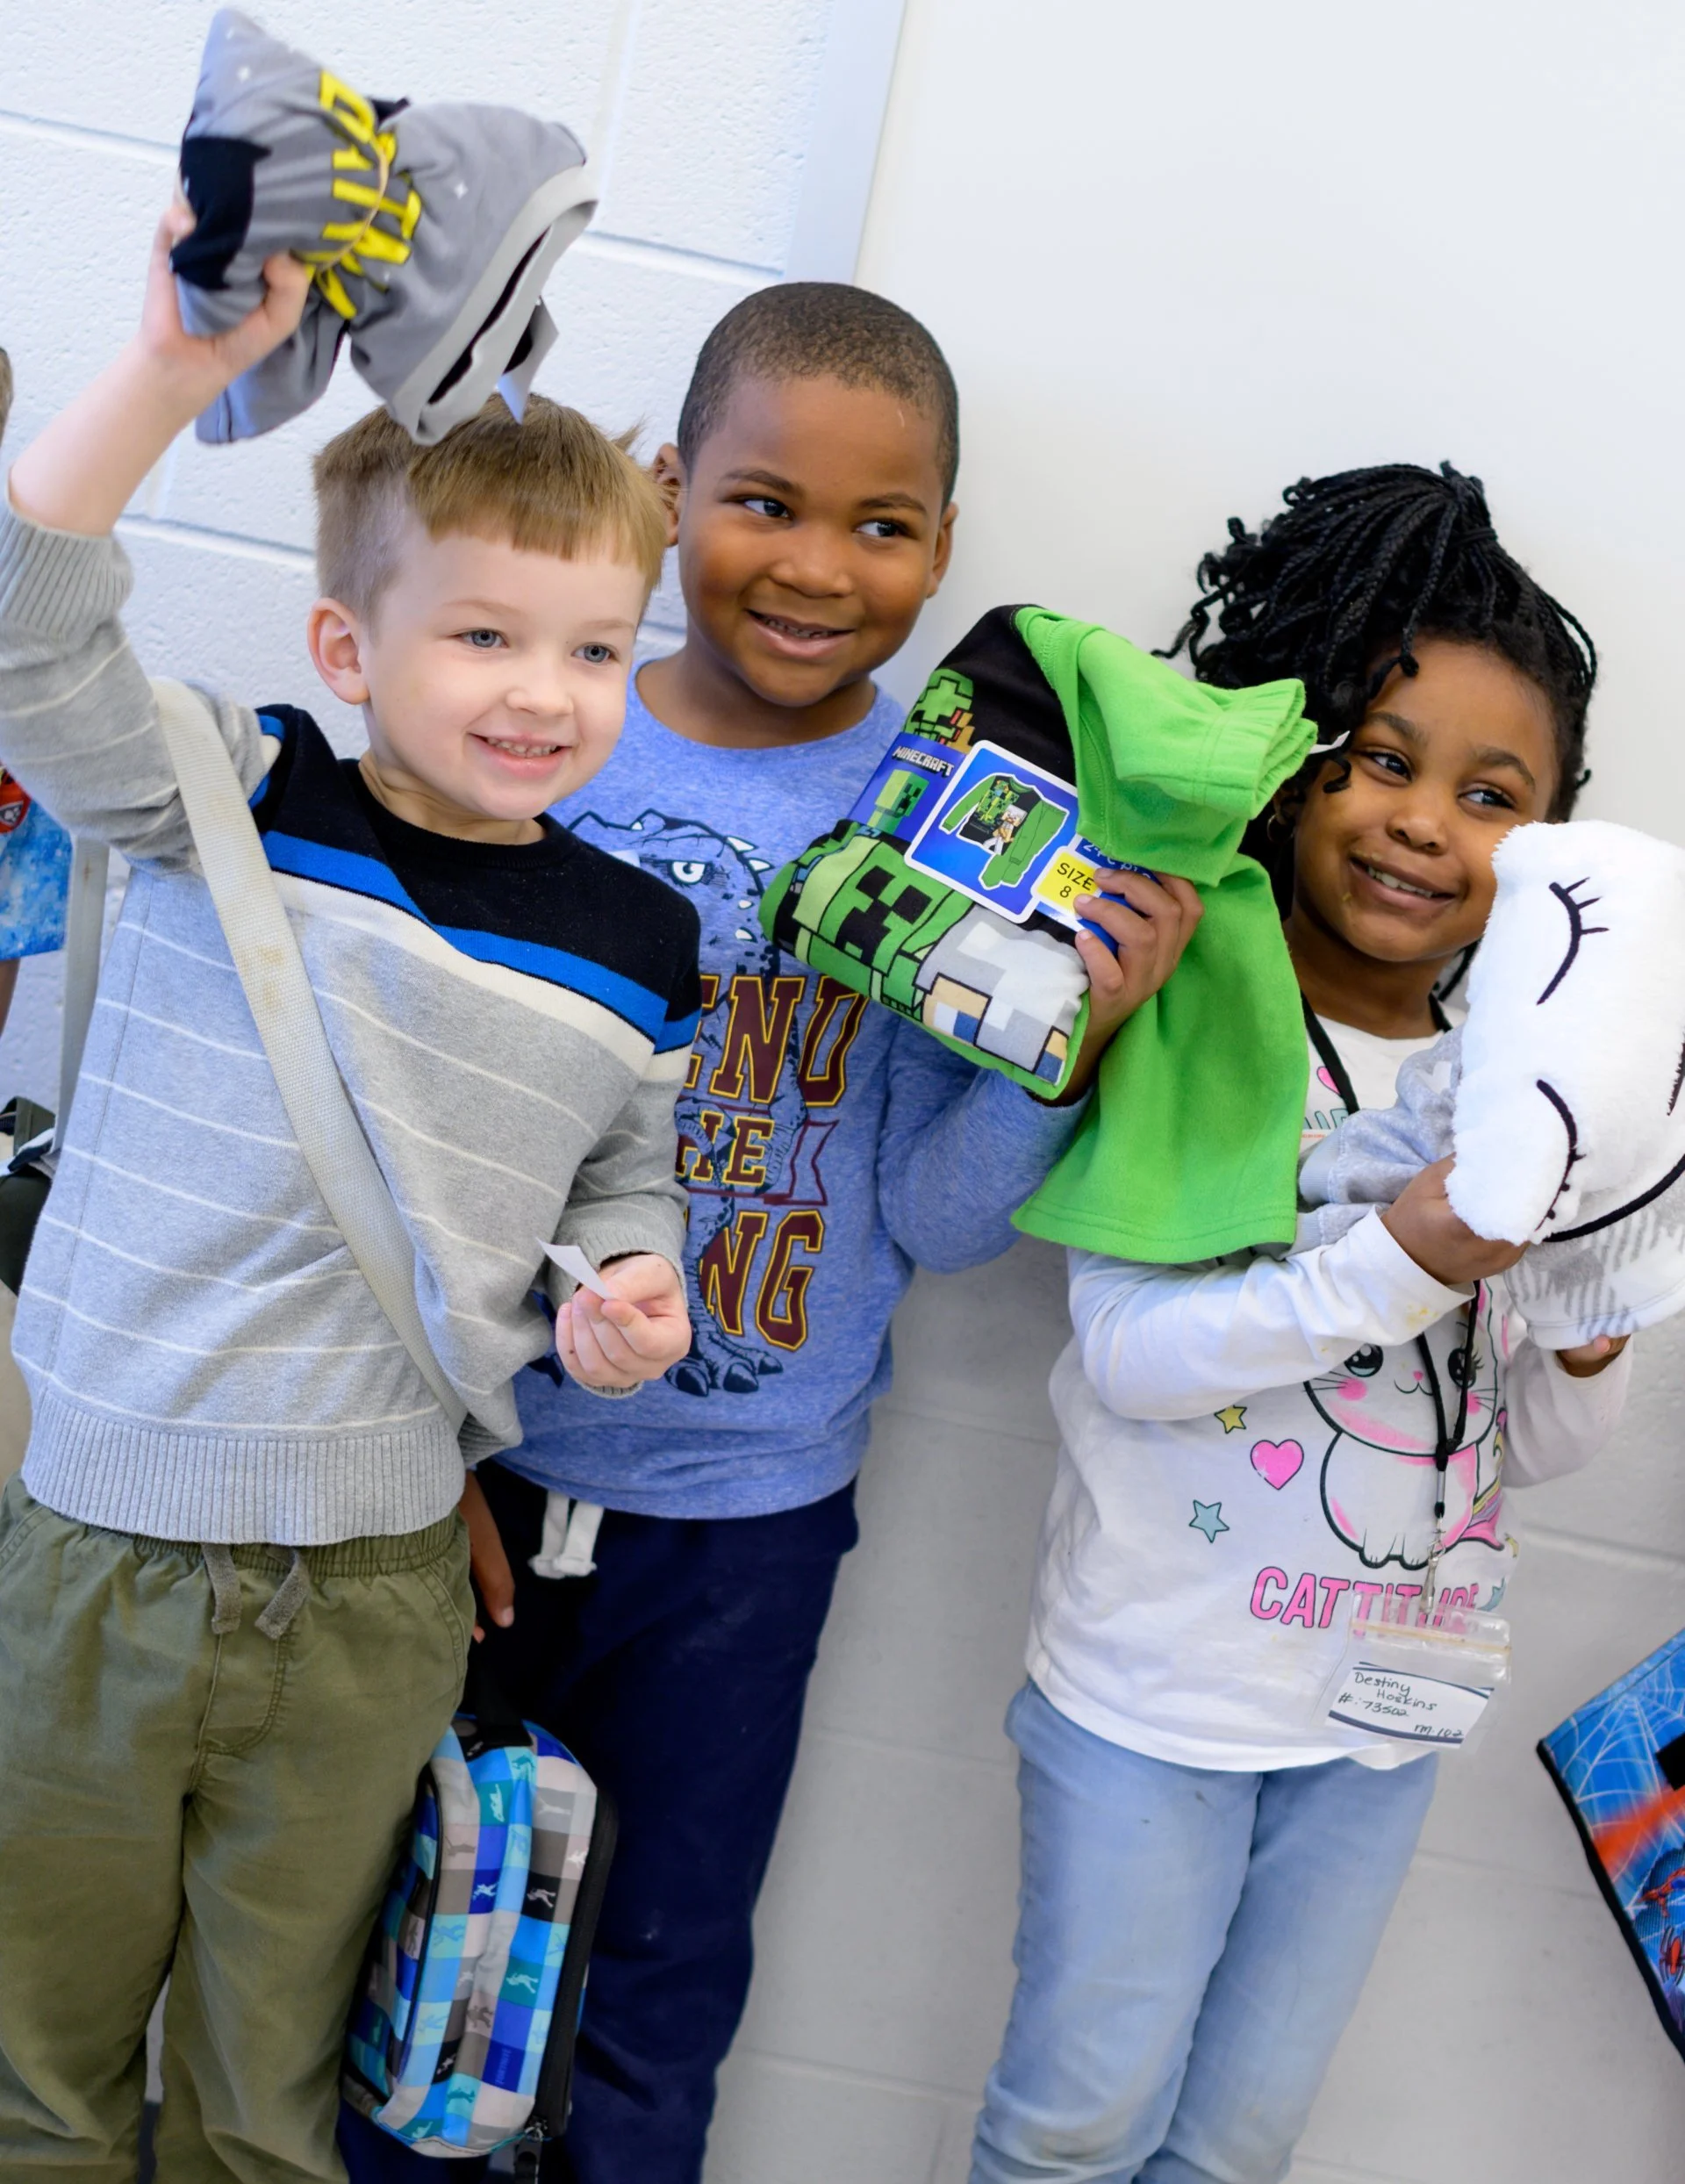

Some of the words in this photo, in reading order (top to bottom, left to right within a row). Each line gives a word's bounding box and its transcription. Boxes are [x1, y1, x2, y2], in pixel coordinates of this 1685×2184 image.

[892, 745, 955, 778] MINECRAFT
[1057, 862, 1095, 891] SIZE
[1059, 885, 1072, 898] 8
[1354, 1671, 1410, 1696] Destiny
[1376, 1688, 1438, 1711] Hoskins
